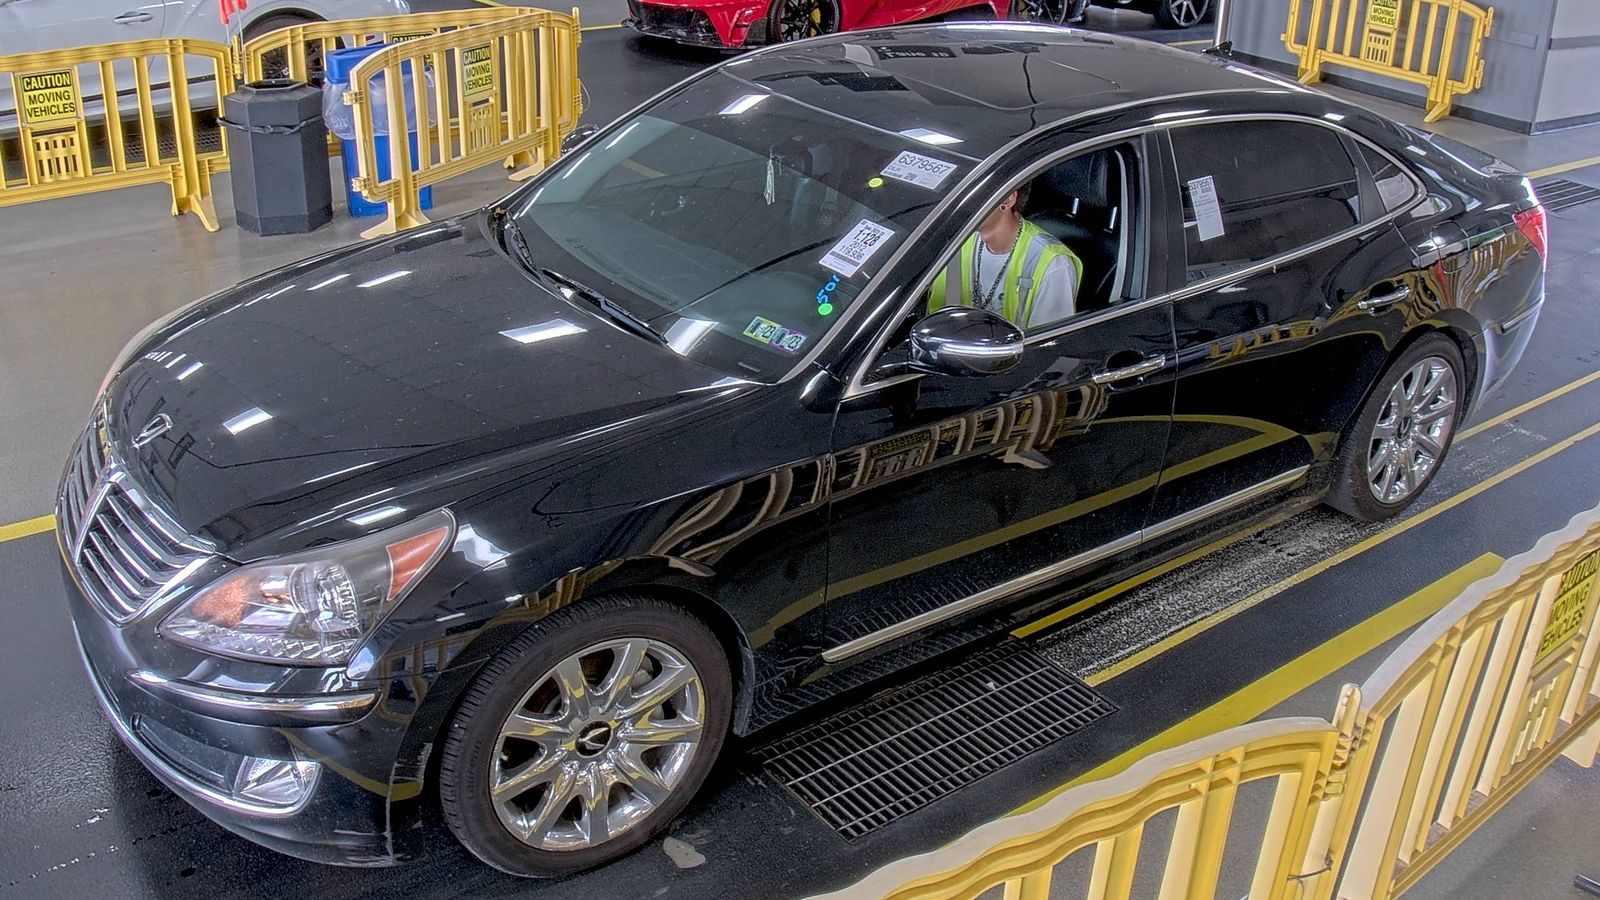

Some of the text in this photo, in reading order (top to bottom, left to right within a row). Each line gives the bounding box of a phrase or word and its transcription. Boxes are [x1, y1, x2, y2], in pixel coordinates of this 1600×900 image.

[1373, 7, 1395, 18] MOVING
[463, 46, 491, 64] CAUTION
[465, 63, 490, 78] MOVING
[23, 73, 70, 90] CAUTION
[464, 74, 492, 91] VEHICLES
[28, 90, 70, 105] MOVING
[26, 102, 76, 118] VEHICLES
[898, 154, 951, 175] 6379567
[1541, 605, 1584, 652] EHICLES
